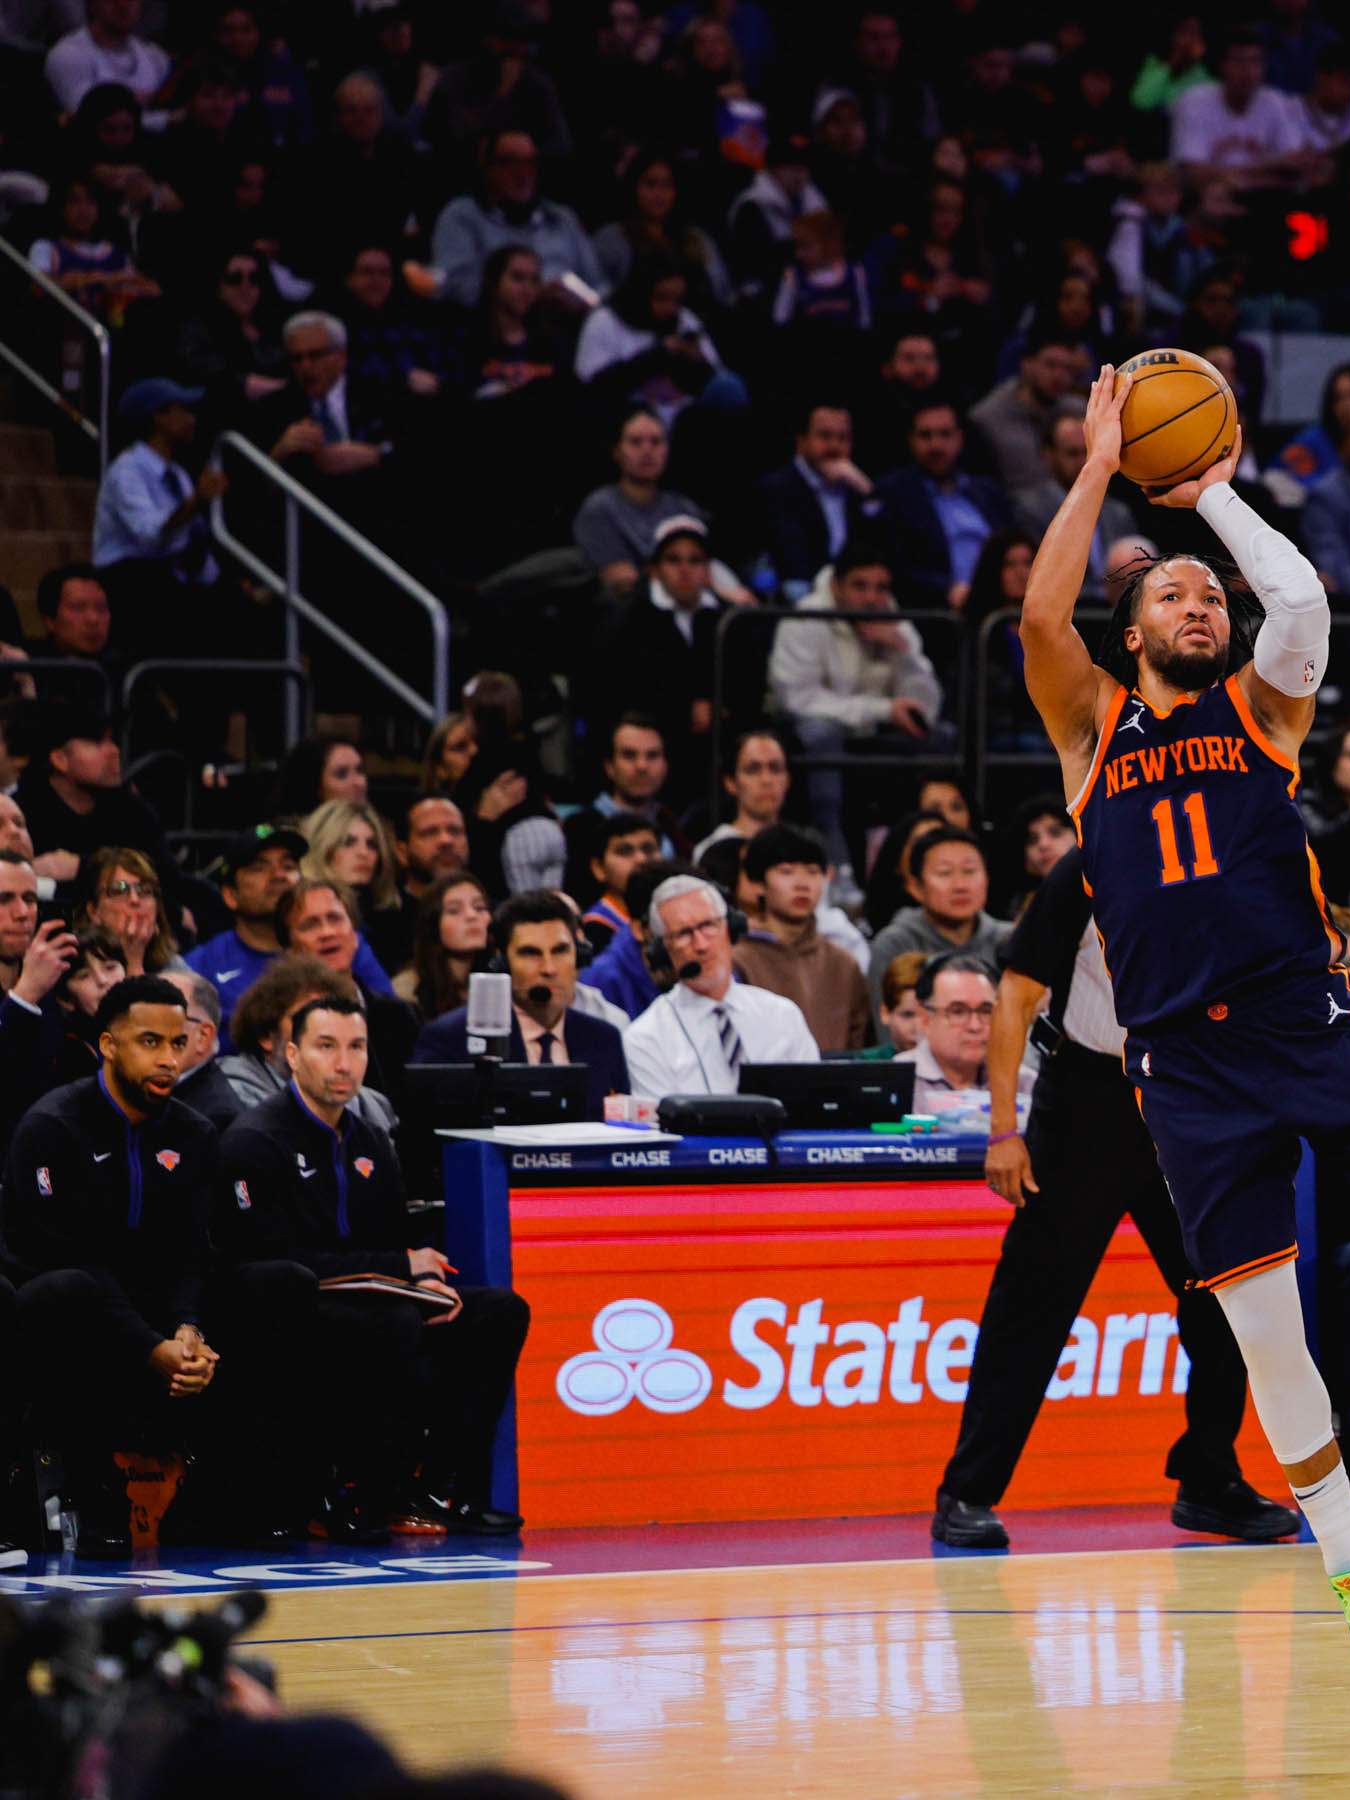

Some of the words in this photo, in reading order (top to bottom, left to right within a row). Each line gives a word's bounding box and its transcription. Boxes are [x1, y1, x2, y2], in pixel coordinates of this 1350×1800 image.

[1104, 745, 1167, 799] NEW
[1168, 735, 1249, 776] YORK
[1150, 789, 1222, 887] 11
[512, 1152, 572, 1169] CHASE
[611, 1149, 671, 1167] CHASE
[708, 1147, 768, 1165] CHASE
[806, 1147, 865, 1164] CHASE
[900, 1146, 958, 1164] CHASE
[722, 1295, 981, 1410] State
